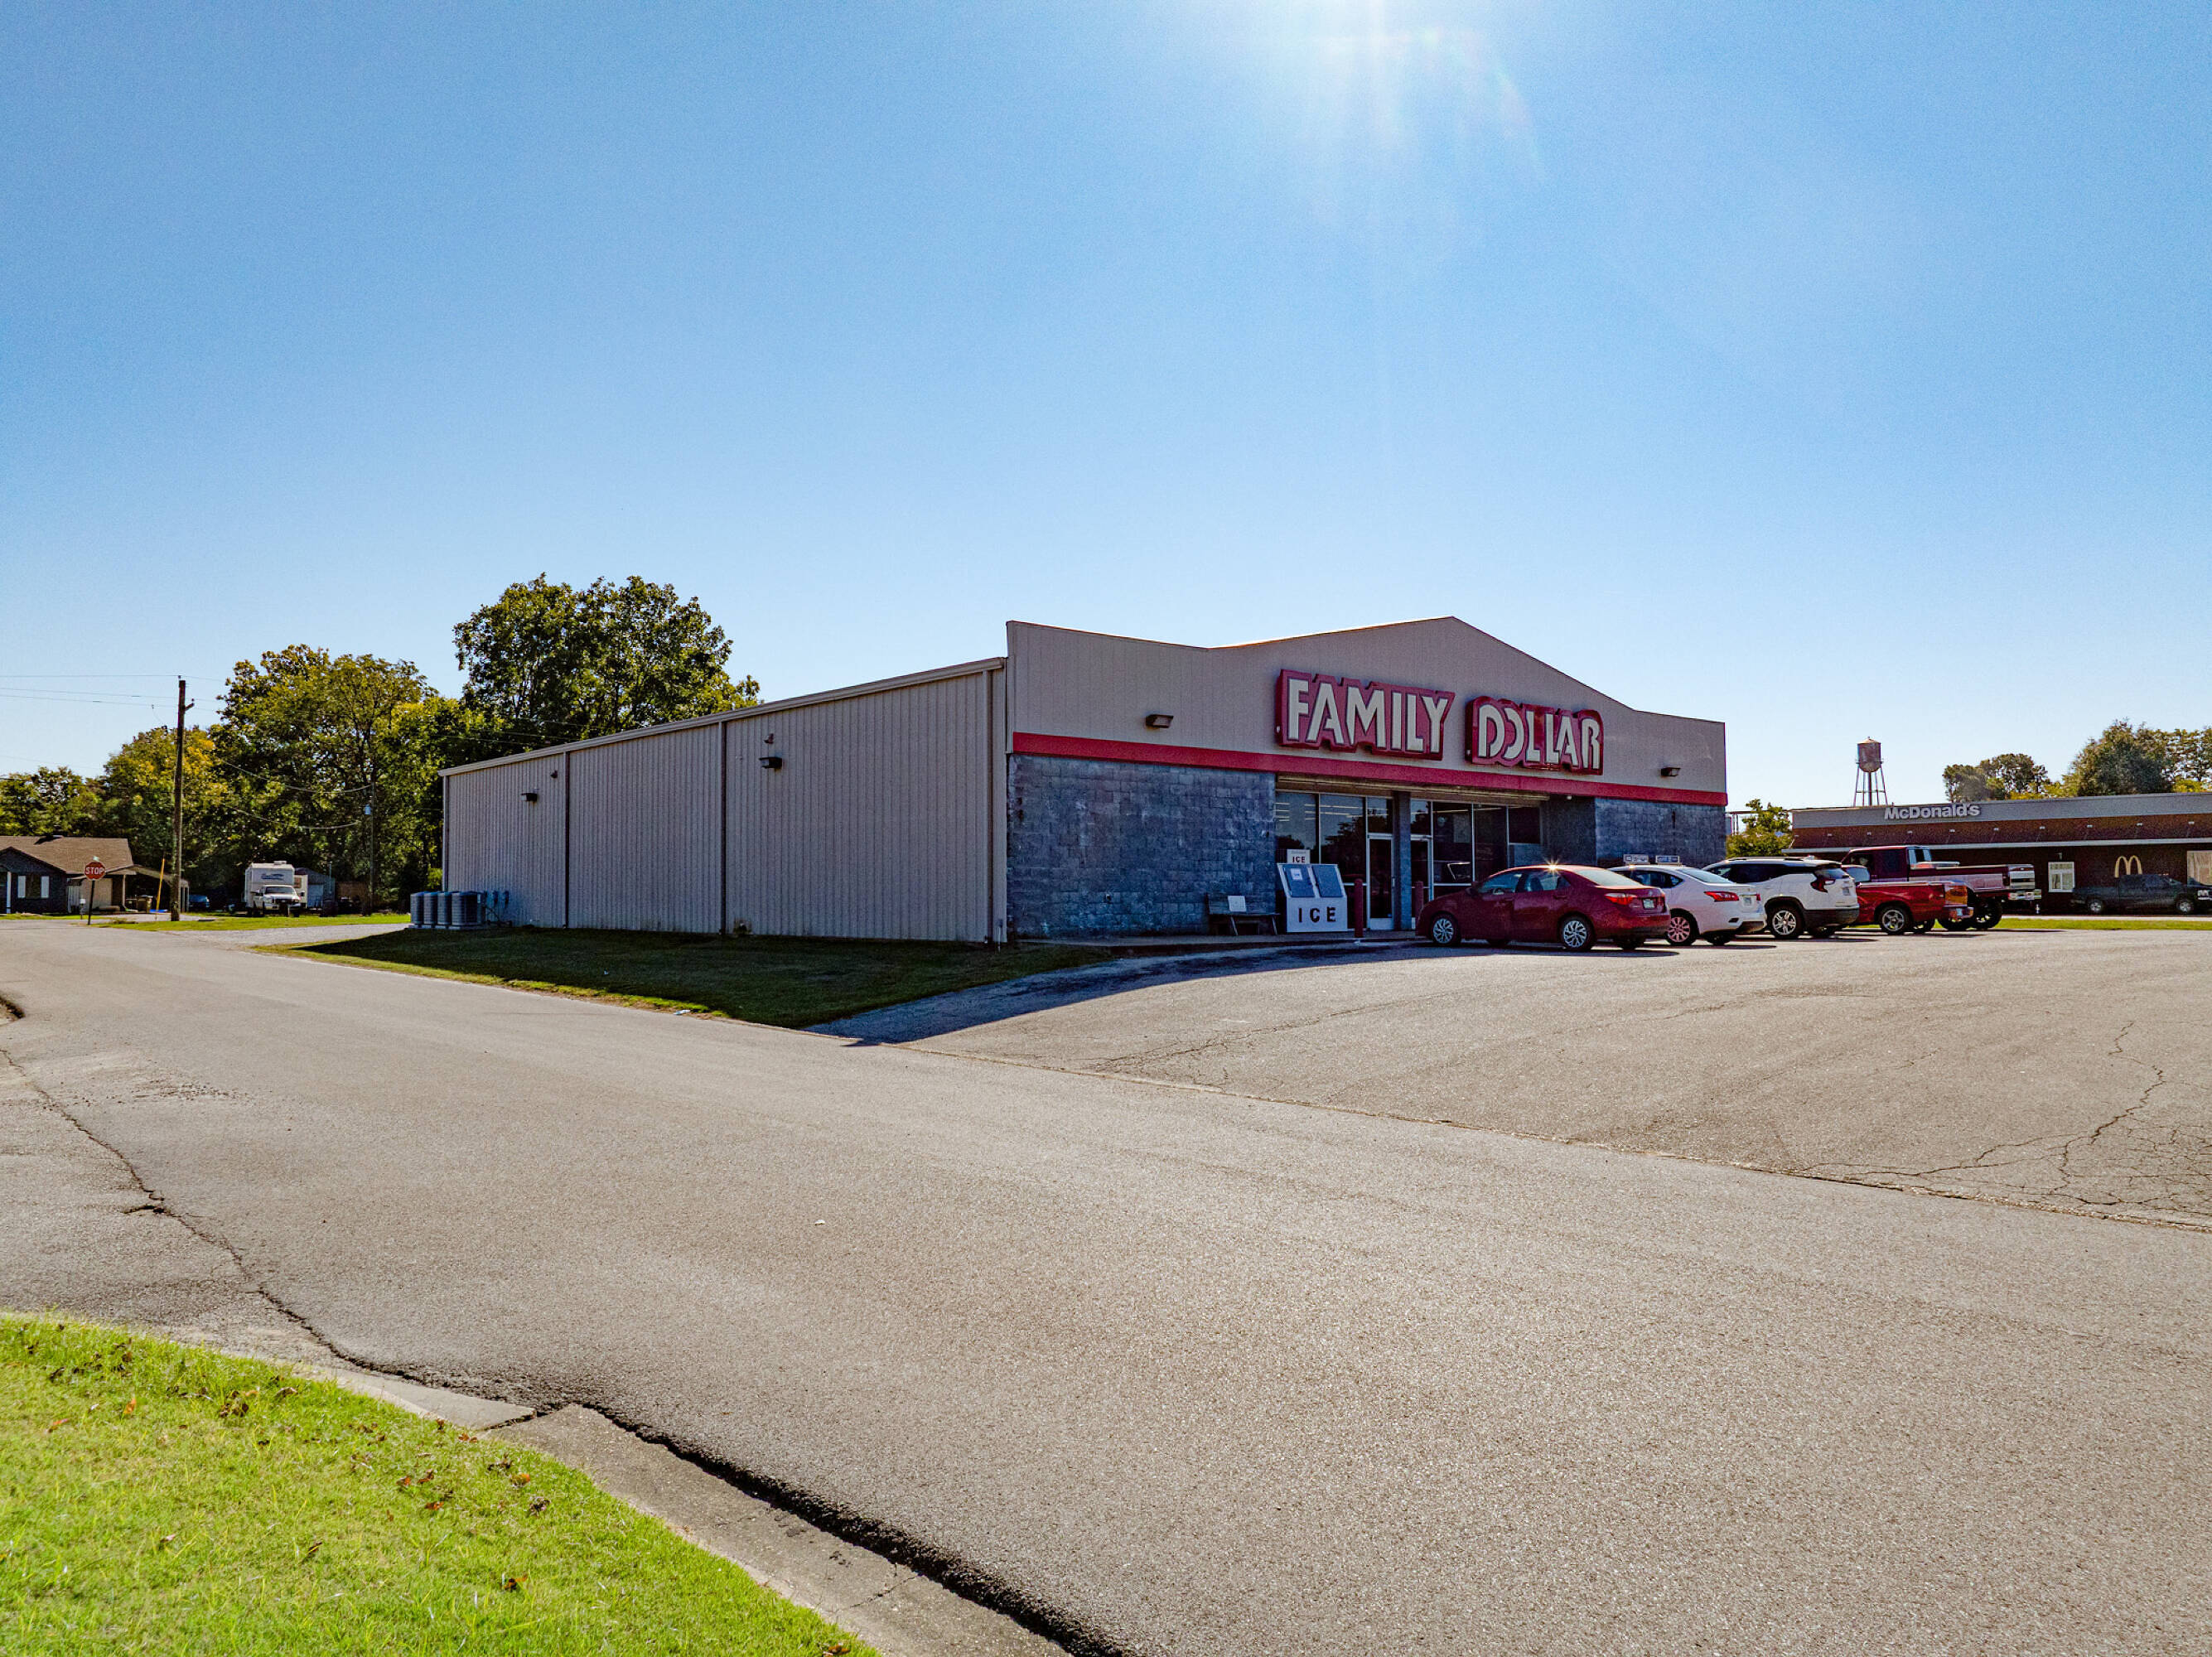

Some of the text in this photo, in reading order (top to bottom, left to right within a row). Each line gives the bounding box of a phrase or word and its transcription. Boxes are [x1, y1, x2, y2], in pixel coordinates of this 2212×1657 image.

[1287, 678, 1600, 770] FAMILY DOLLAR
[1884, 801, 1981, 819] McDonald's
[86, 867, 104, 875] STOP
[1298, 906, 1336, 923] ICE
